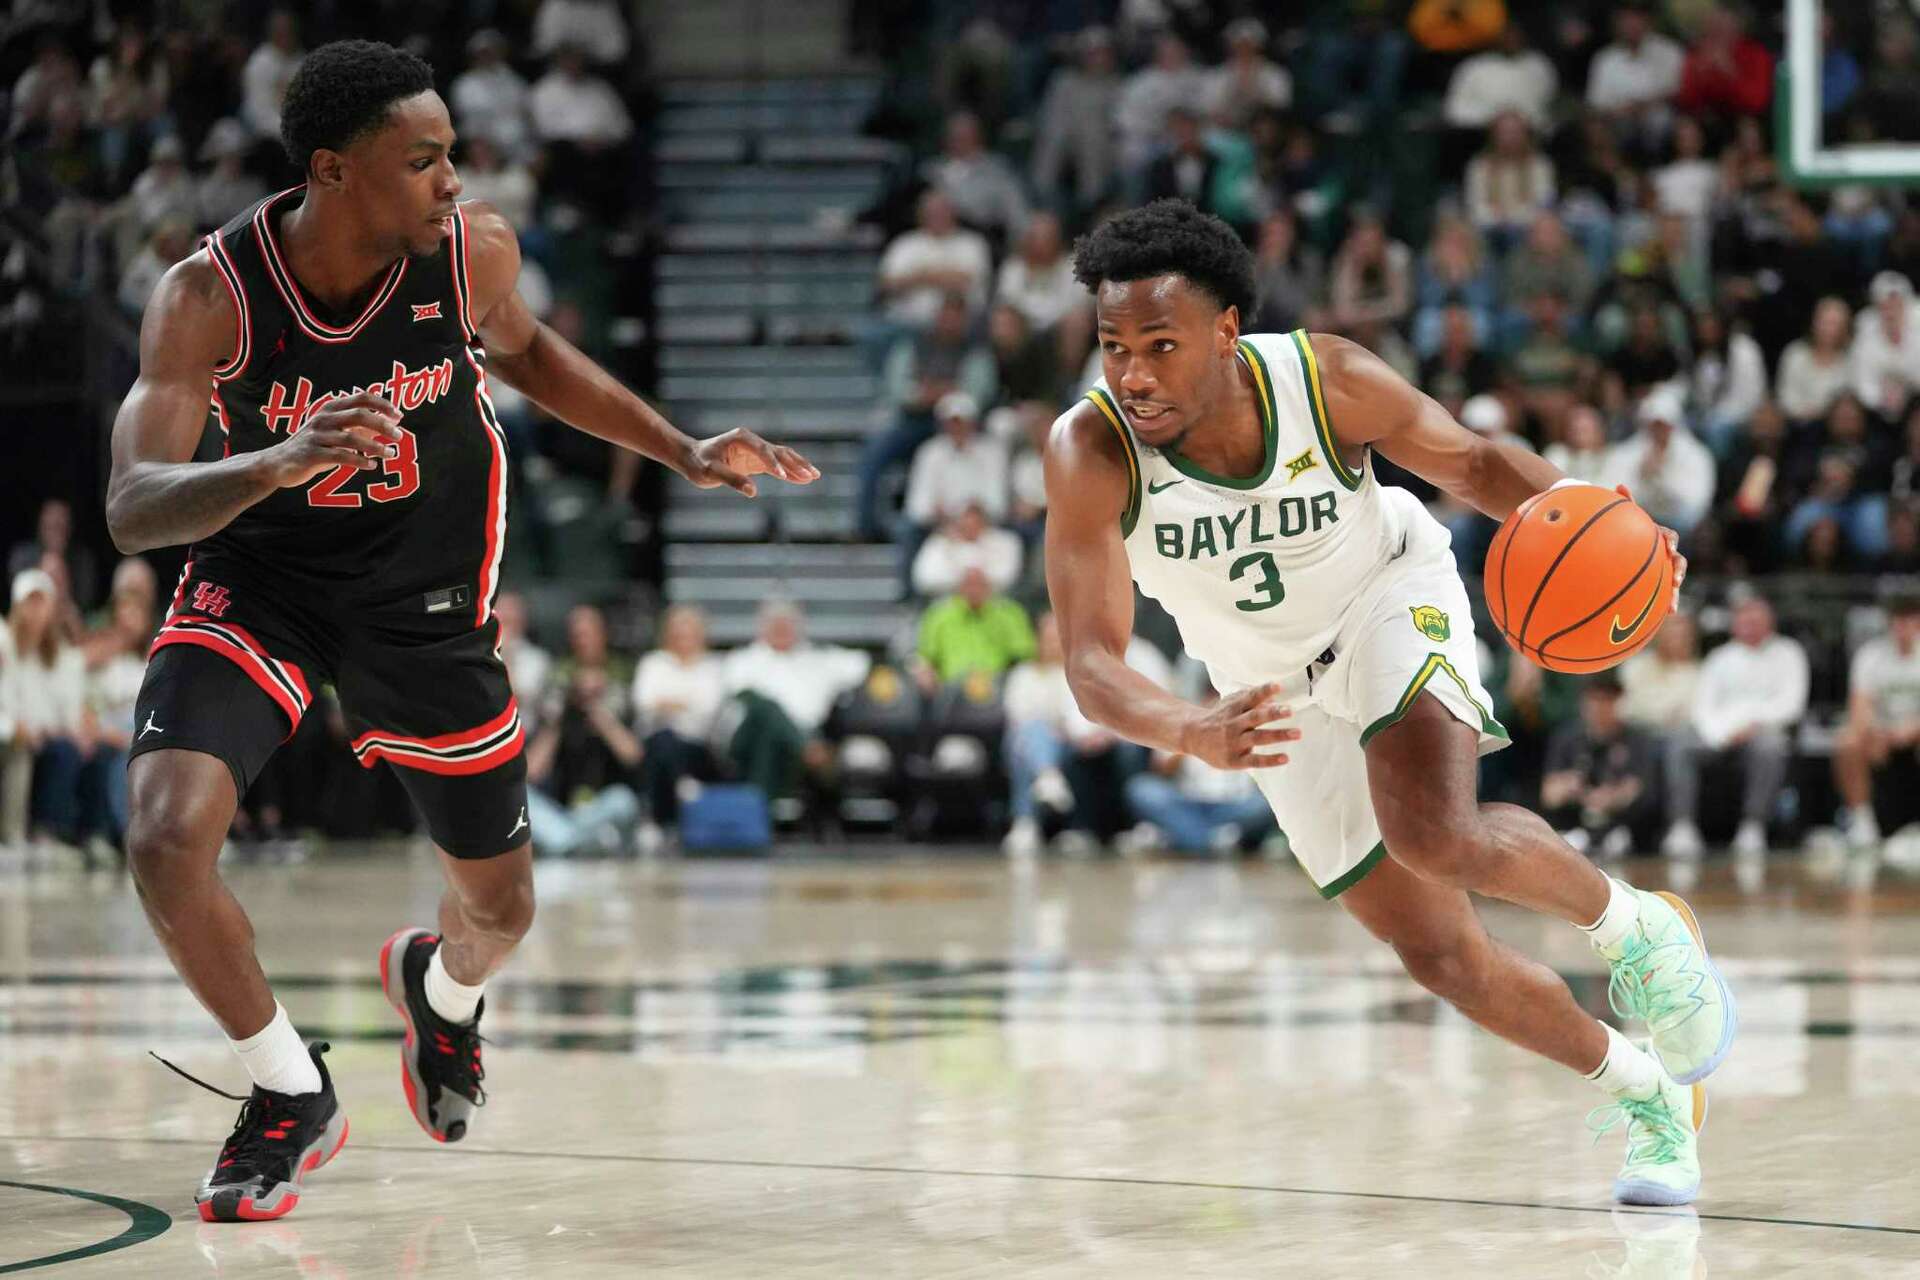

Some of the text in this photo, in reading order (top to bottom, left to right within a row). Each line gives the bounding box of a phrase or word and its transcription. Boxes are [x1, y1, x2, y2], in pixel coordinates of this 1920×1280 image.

[260, 357, 453, 436] Hston
[1154, 490, 1340, 561] BAYLOR
[1228, 551, 1286, 612] 3
